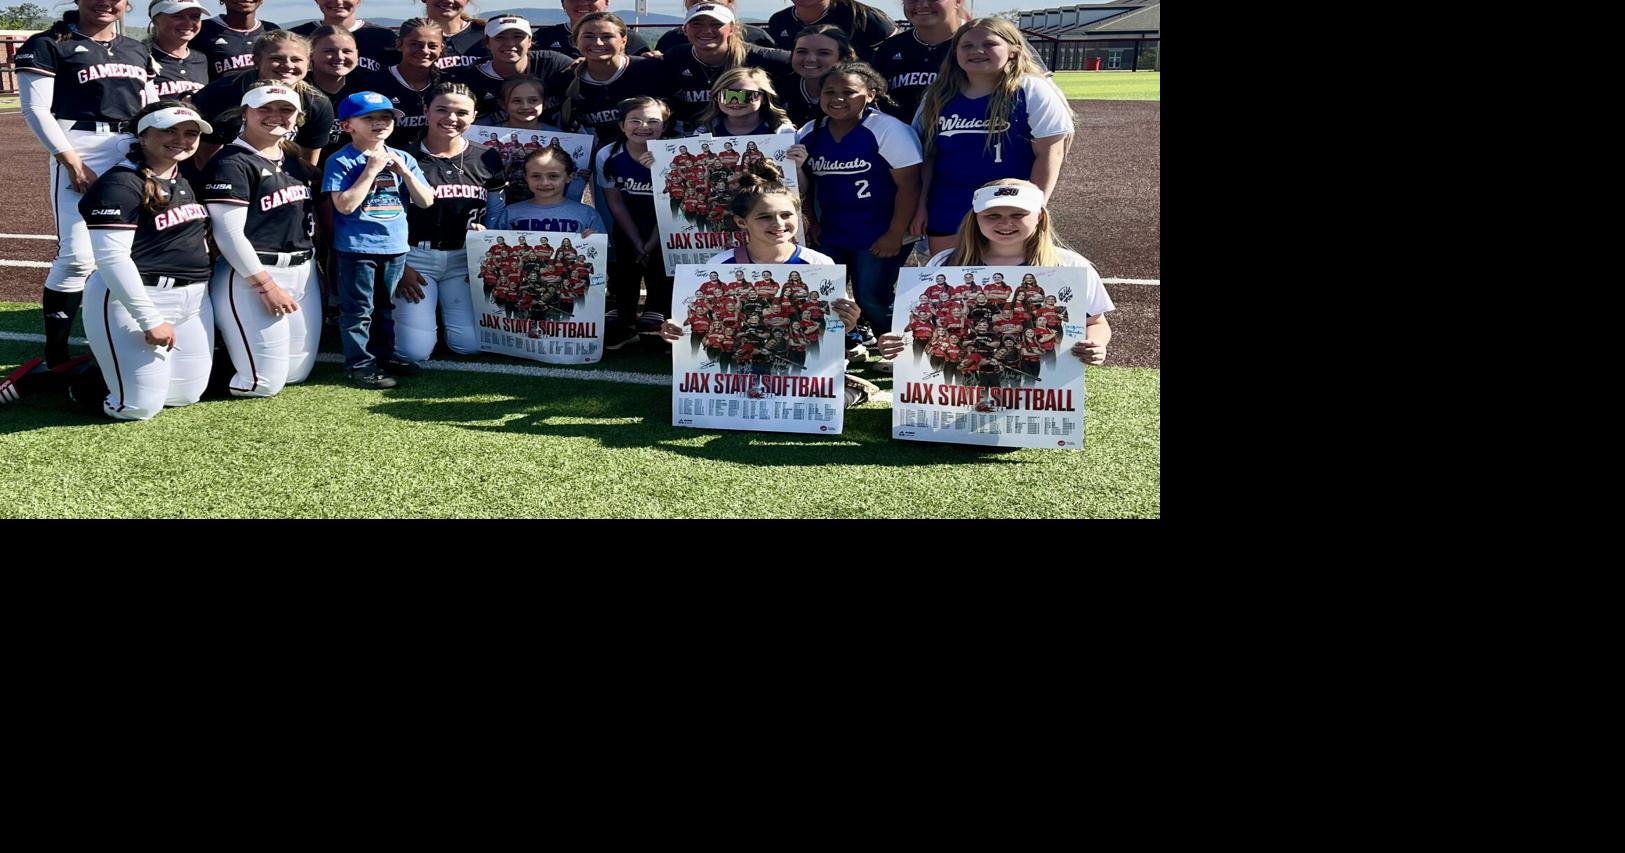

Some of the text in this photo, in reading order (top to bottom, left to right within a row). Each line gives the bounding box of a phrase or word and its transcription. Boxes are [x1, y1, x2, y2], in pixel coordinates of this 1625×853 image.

[993, 143, 1003, 163] 1
[807, 156, 870, 173] Wildcats
[854, 180, 872, 199] 2
[666, 232, 693, 250] JAX
[694, 230, 729, 249] STATE
[480, 312, 599, 339] JAX STATE SOFTBALL
[679, 372, 837, 399] JAX STATE SOFTBALL
[901, 382, 1075, 412] JAX STATE SOFTBALL
